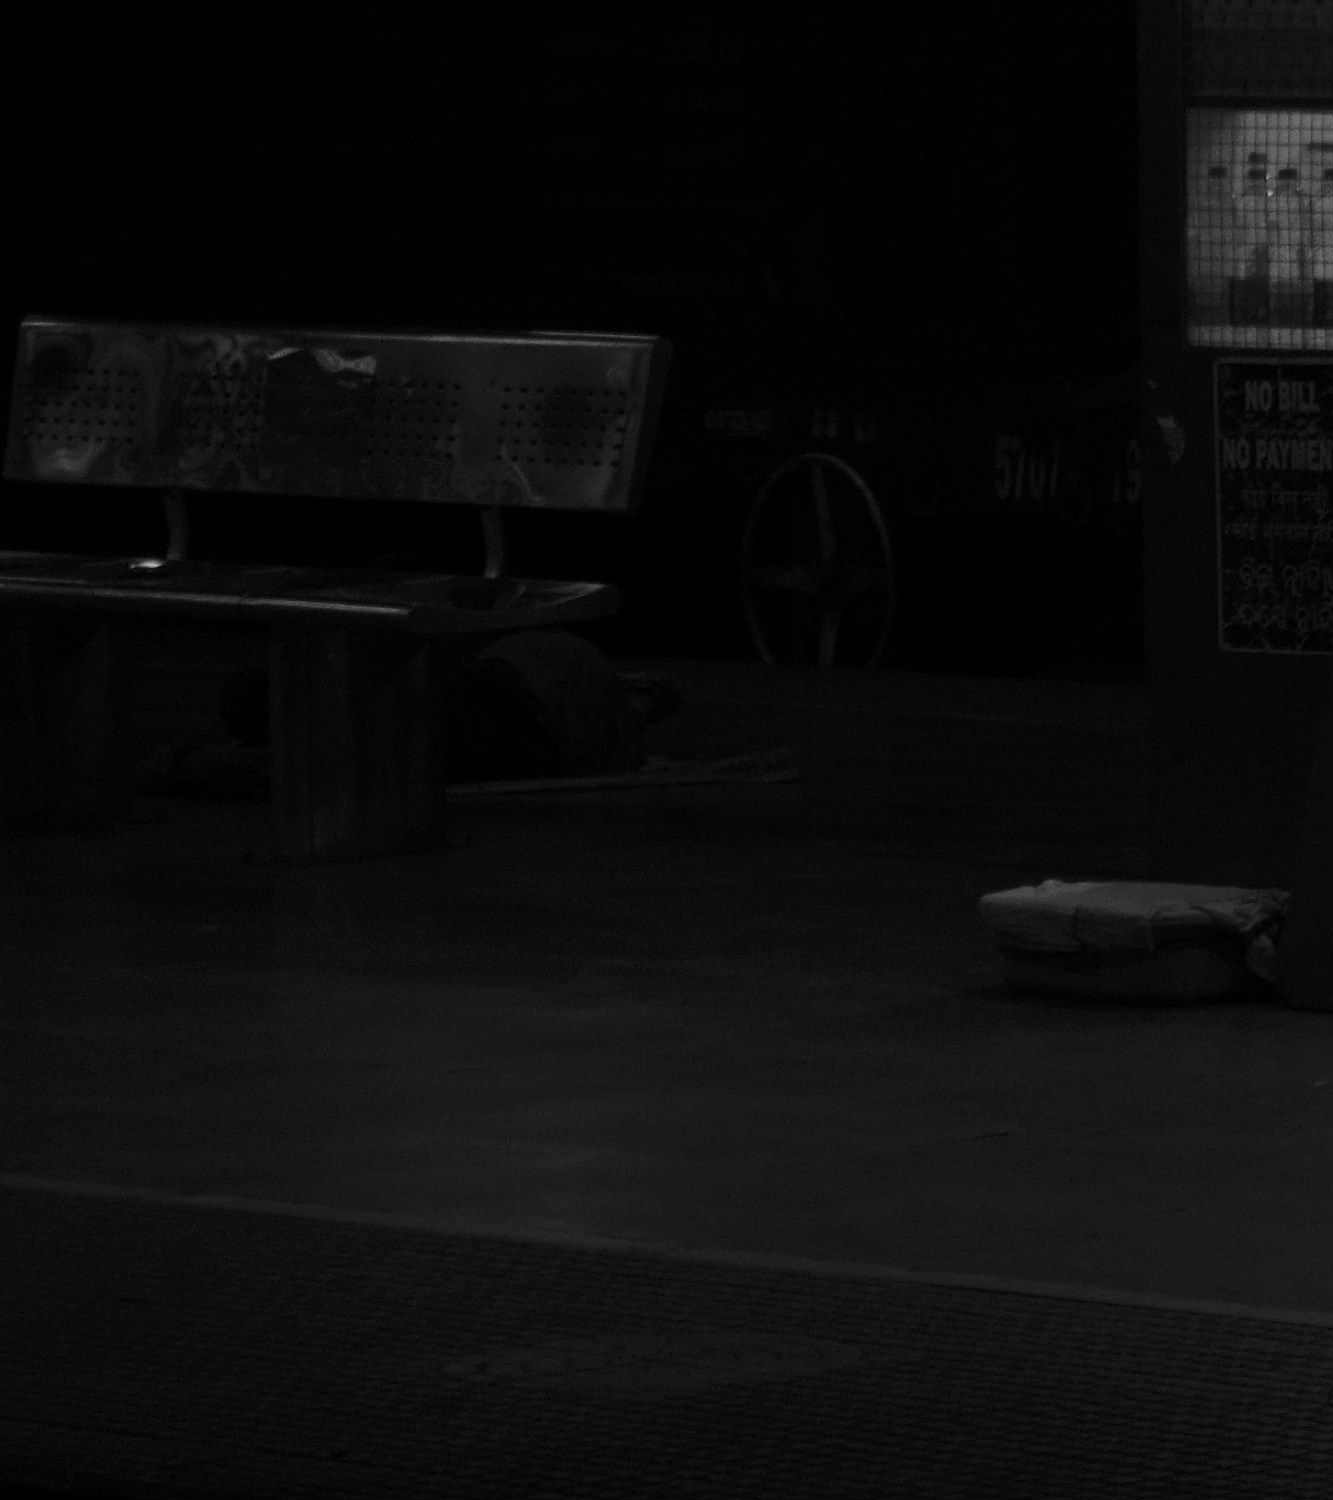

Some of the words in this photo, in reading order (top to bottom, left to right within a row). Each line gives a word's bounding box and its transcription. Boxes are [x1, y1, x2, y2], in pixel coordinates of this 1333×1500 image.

[1244, 380, 1272, 412] NO
[1278, 380, 1320, 413] BILL
[1223, 438, 1250, 470] NO
